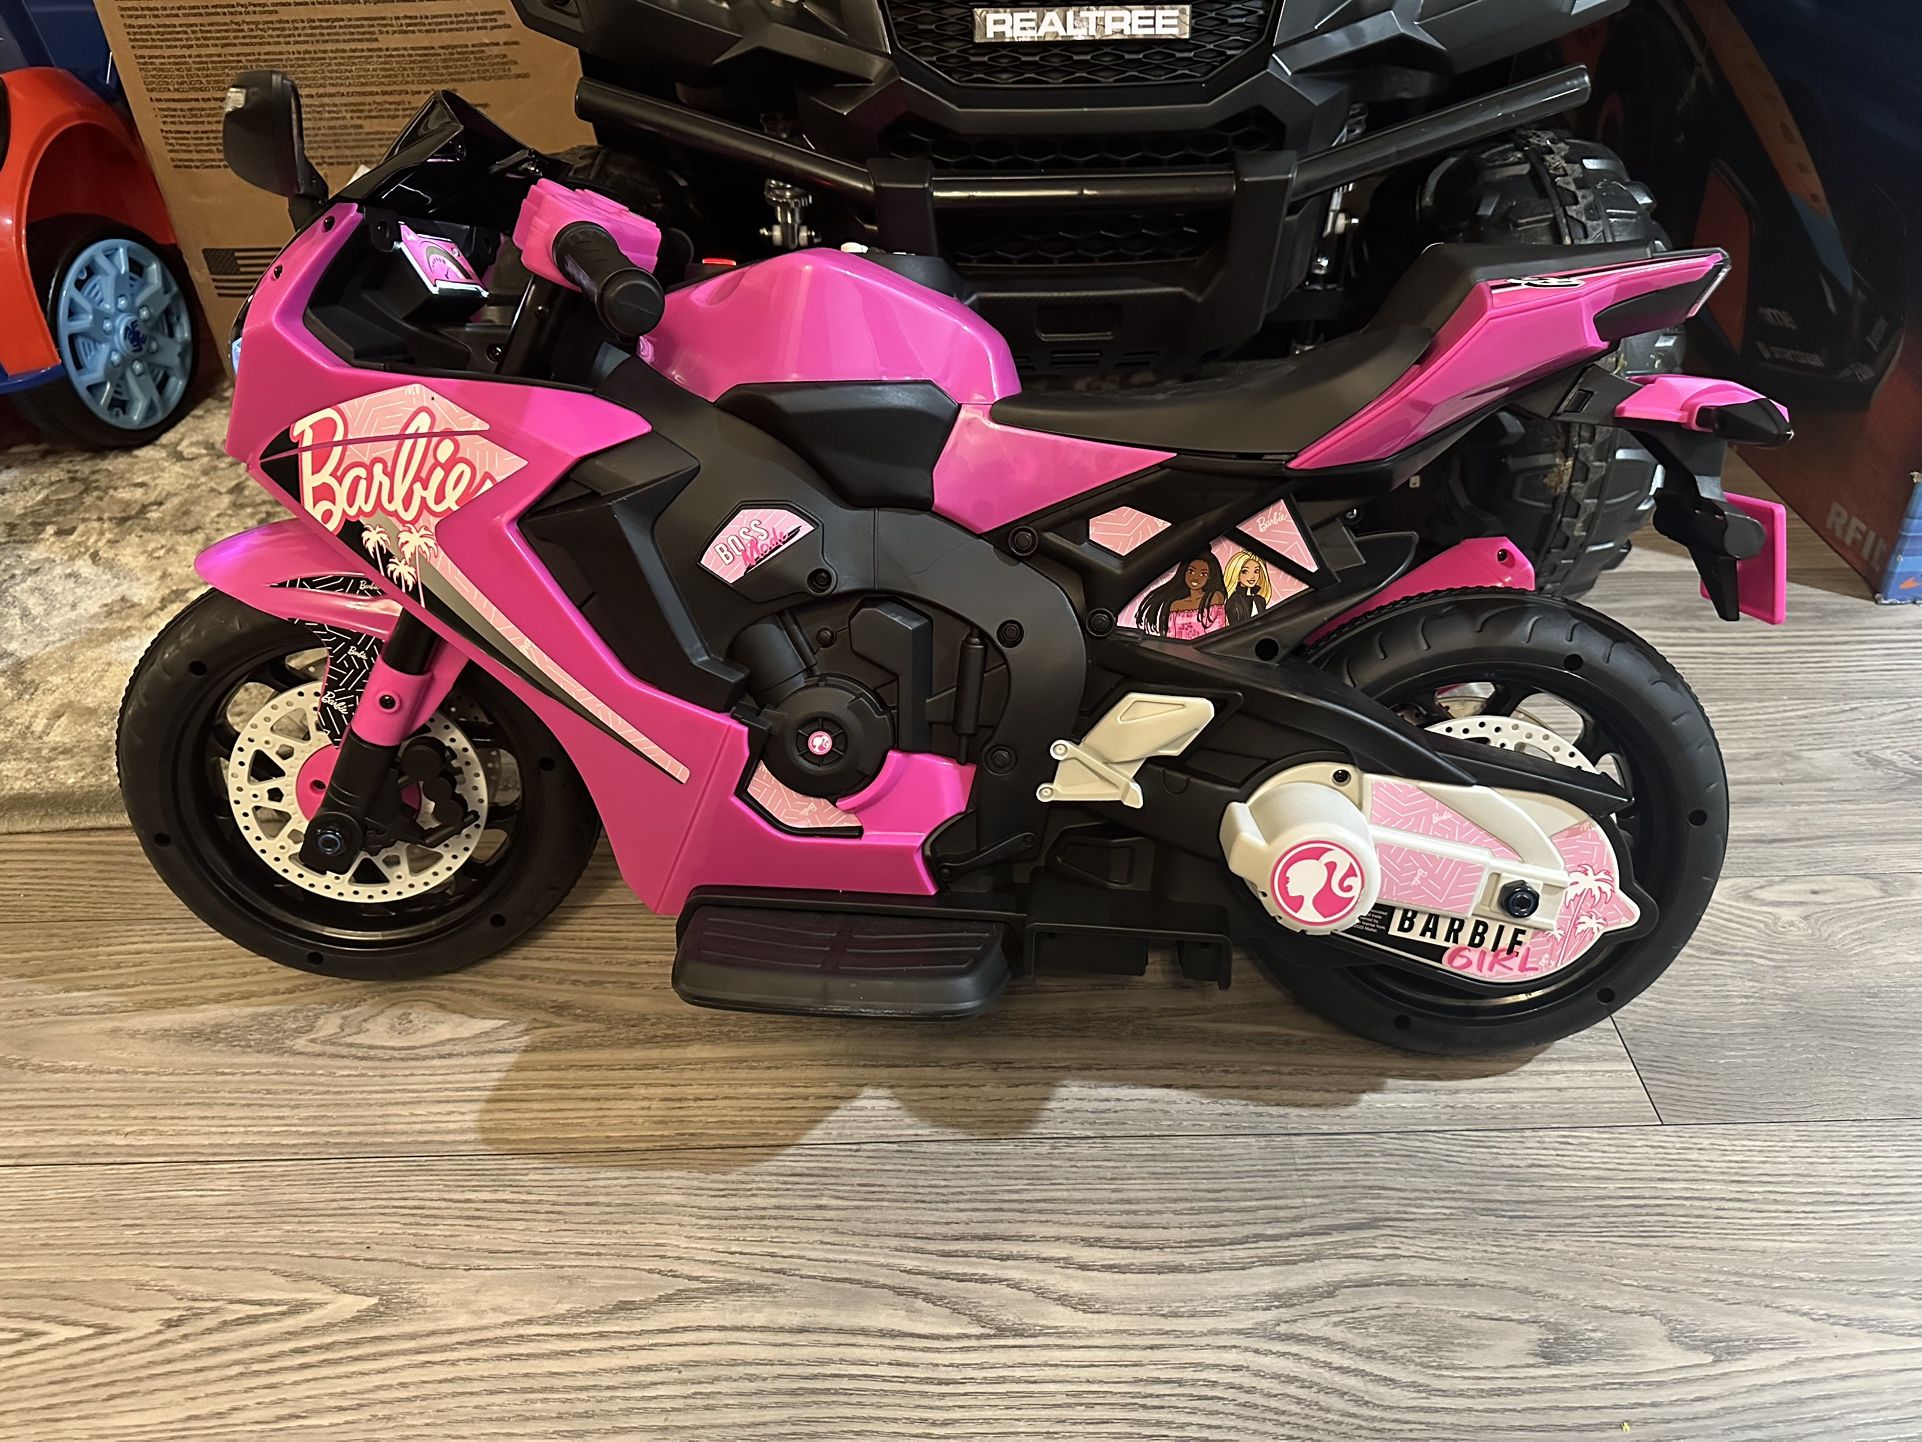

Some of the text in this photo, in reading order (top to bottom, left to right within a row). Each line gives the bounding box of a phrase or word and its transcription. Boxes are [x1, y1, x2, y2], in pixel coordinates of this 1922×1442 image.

[985, 9, 1180, 39] REALTREE
[290, 406, 493, 533] Barbie
[1256, 511, 1288, 533] Barbie
[713, 519, 769, 566] BOSS
[321, 690, 348, 716] Barbie
[1397, 908, 1527, 956] BARBIE
[1447, 946, 1540, 974] GIRL
